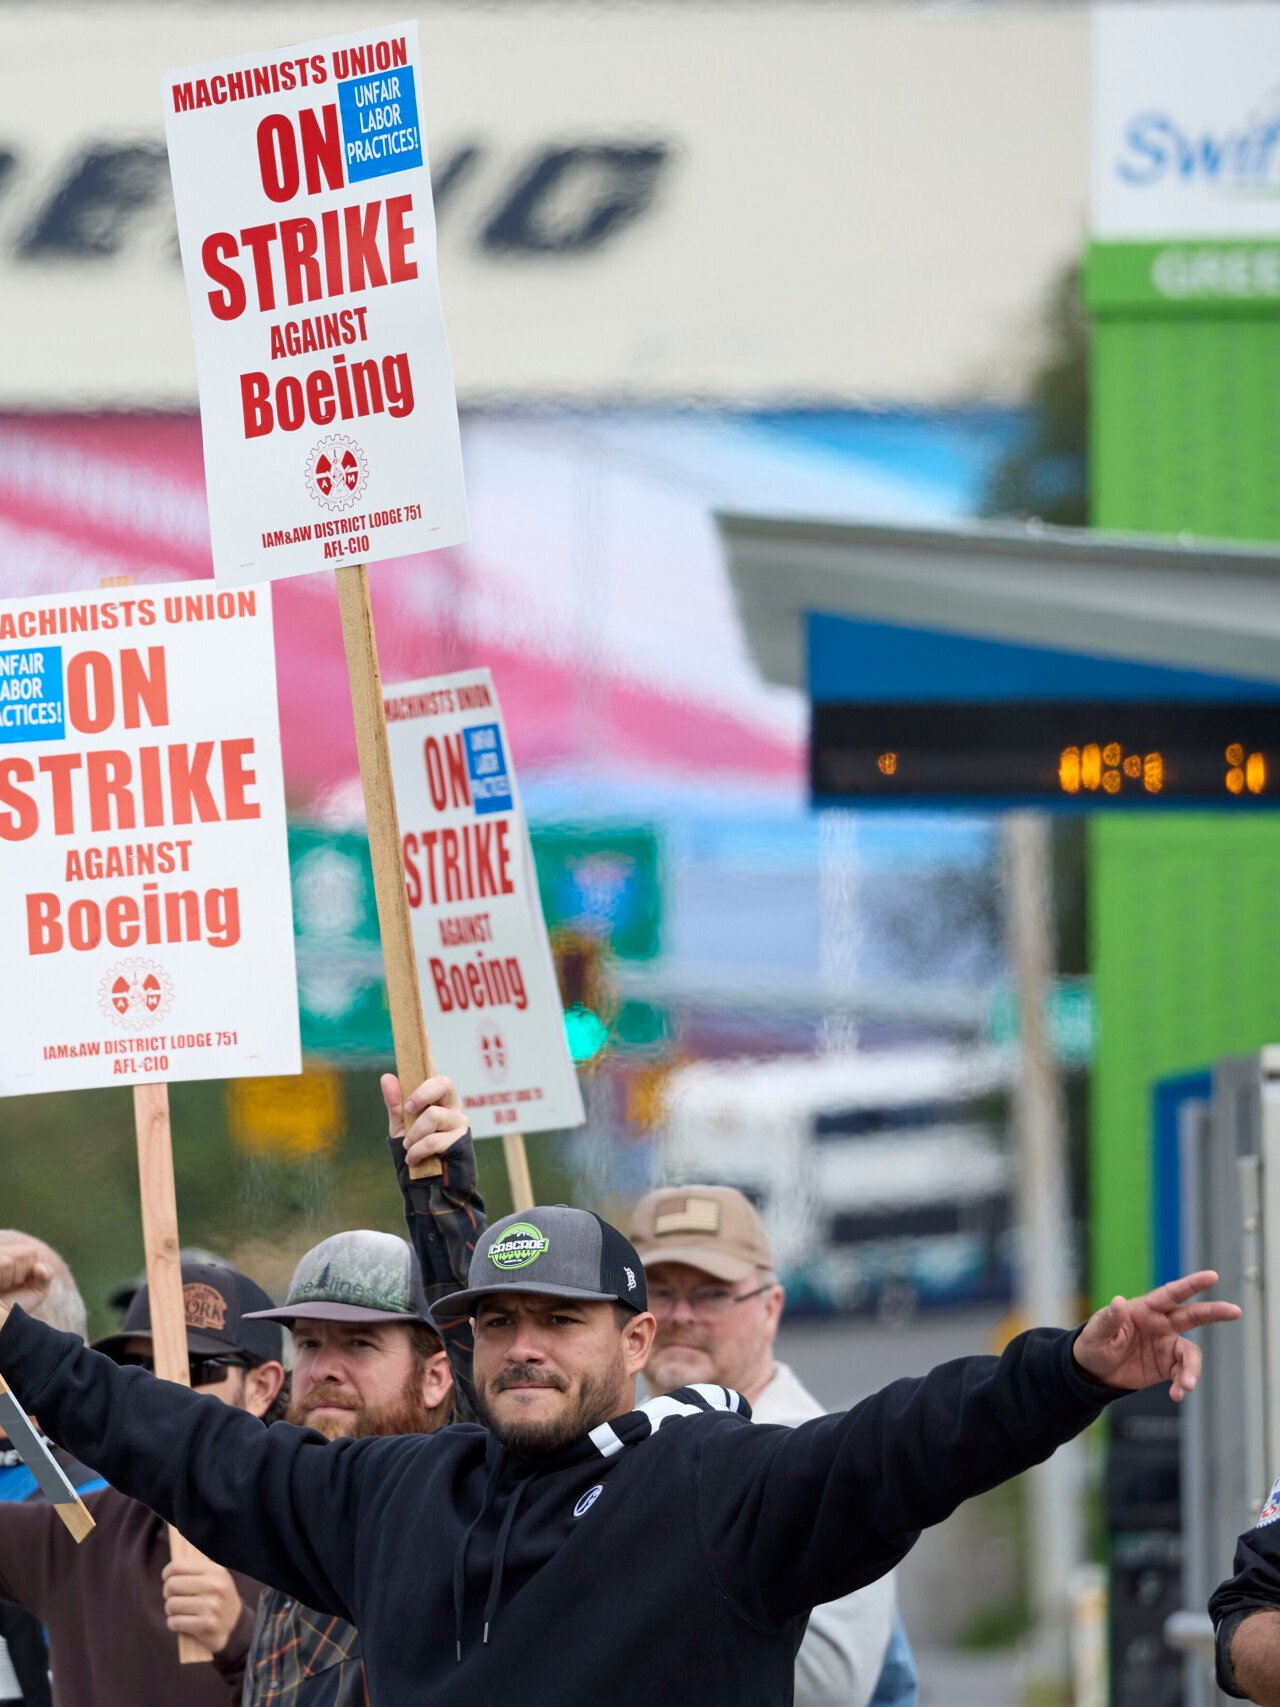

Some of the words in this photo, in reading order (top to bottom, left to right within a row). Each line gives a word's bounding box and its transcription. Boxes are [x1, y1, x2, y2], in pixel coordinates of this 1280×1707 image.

[172, 55, 327, 113] MACHINISTS
[332, 37, 407, 81] UNION
[354, 81, 401, 111] UNFAIR
[360, 109, 402, 134] LABOR
[256, 103, 345, 203] ON
[347, 126, 419, 164] PRACTICES!
[201, 194, 418, 321] STRIKE
[270, 307, 367, 360] AGAINST
[240, 352, 414, 439] Boeing
[262, 525, 311, 548] IAM&AW
[314, 515, 366, 538] DISTRICT
[369, 508, 403, 528] LODGE
[404, 504, 422, 521] 751
[324, 535, 369, 558] AFL-CIO
[164, 590, 256, 624] UNION
[66, 645, 169, 735] ON
[455, 684, 492, 711] UNION
[424, 732, 471, 812] ON
[65, 840, 193, 882] AGAINST
[401, 819, 515, 909] STRIKE
[26, 882, 241, 955] Boeing
[438, 912, 494, 949] AGAINST
[429, 950, 528, 1013] Boeing
[43, 1042, 100, 1060] IAM&AW
[104, 1036, 167, 1054] DISTRICT
[171, 1033, 212, 1049] LODGE
[216, 1031, 238, 1046] 751
[113, 1055, 169, 1074] AFL-CIO
[491, 1239, 545, 1254] CASCADE
[184, 1299, 222, 1322] ORK
